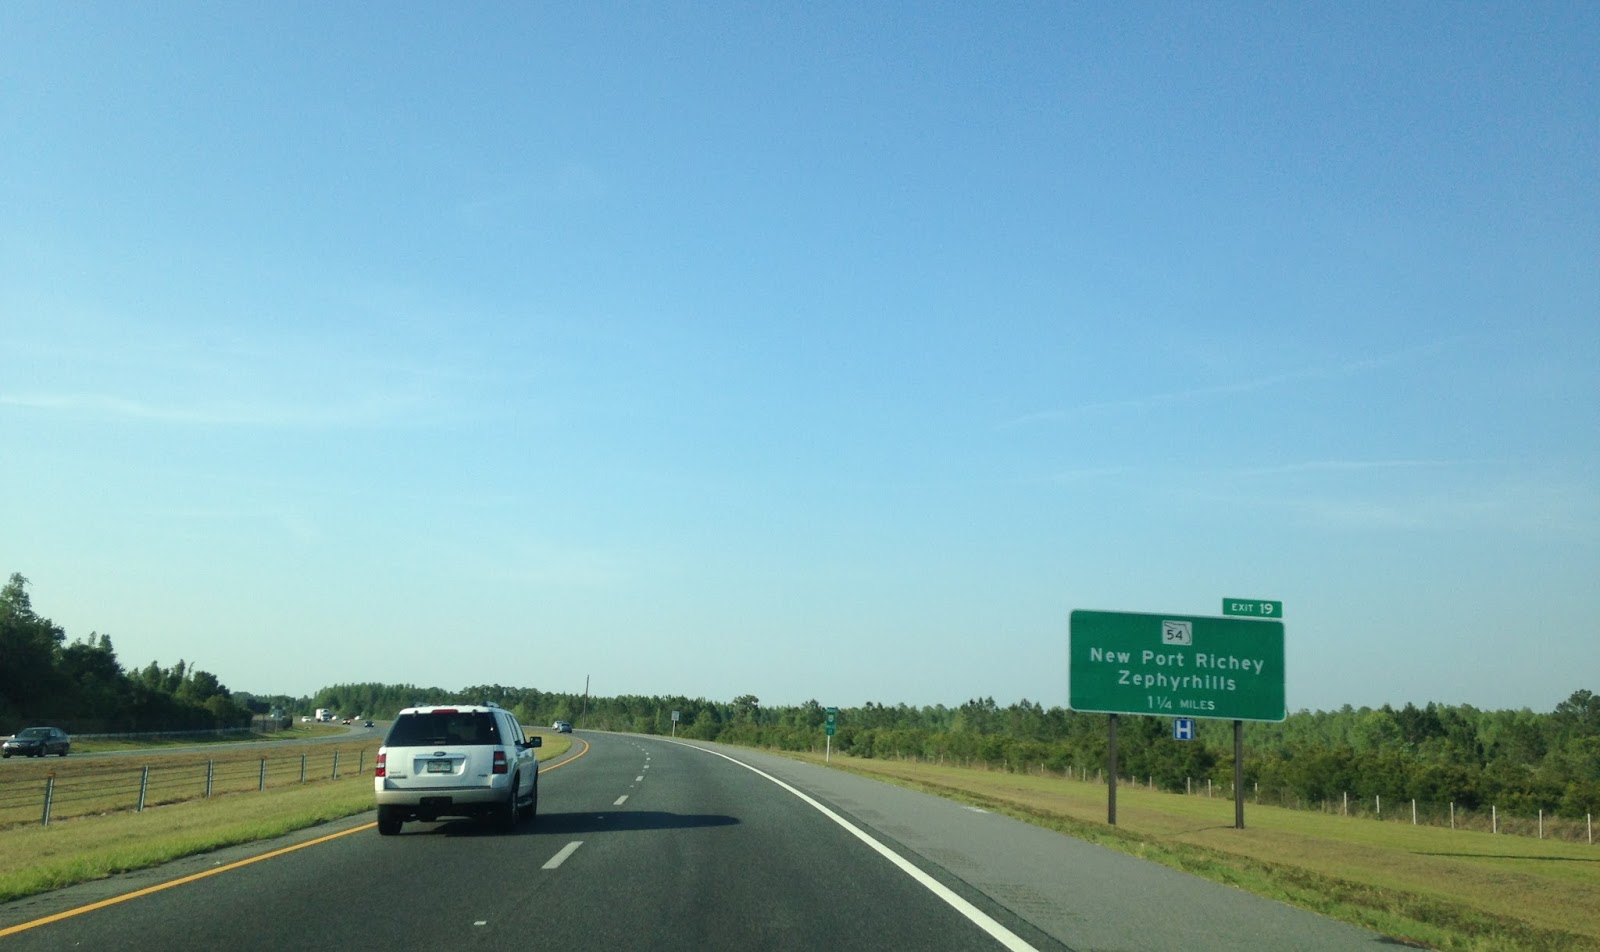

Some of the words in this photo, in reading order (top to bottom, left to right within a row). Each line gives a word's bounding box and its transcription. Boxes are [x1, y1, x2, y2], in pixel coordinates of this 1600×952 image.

[1231, 603, 1254, 612] EXIT
[1259, 603, 1274, 615] 19
[1166, 629, 1183, 641] 54
[1090, 647, 1131, 664] New
[1142, 650, 1185, 667] Port
[1196, 653, 1265, 675] Richey
[1118, 669, 1237, 692] Zephyrhills
[1179, 699, 1215, 711] MILES
[1175, 719, 1192, 739] H
